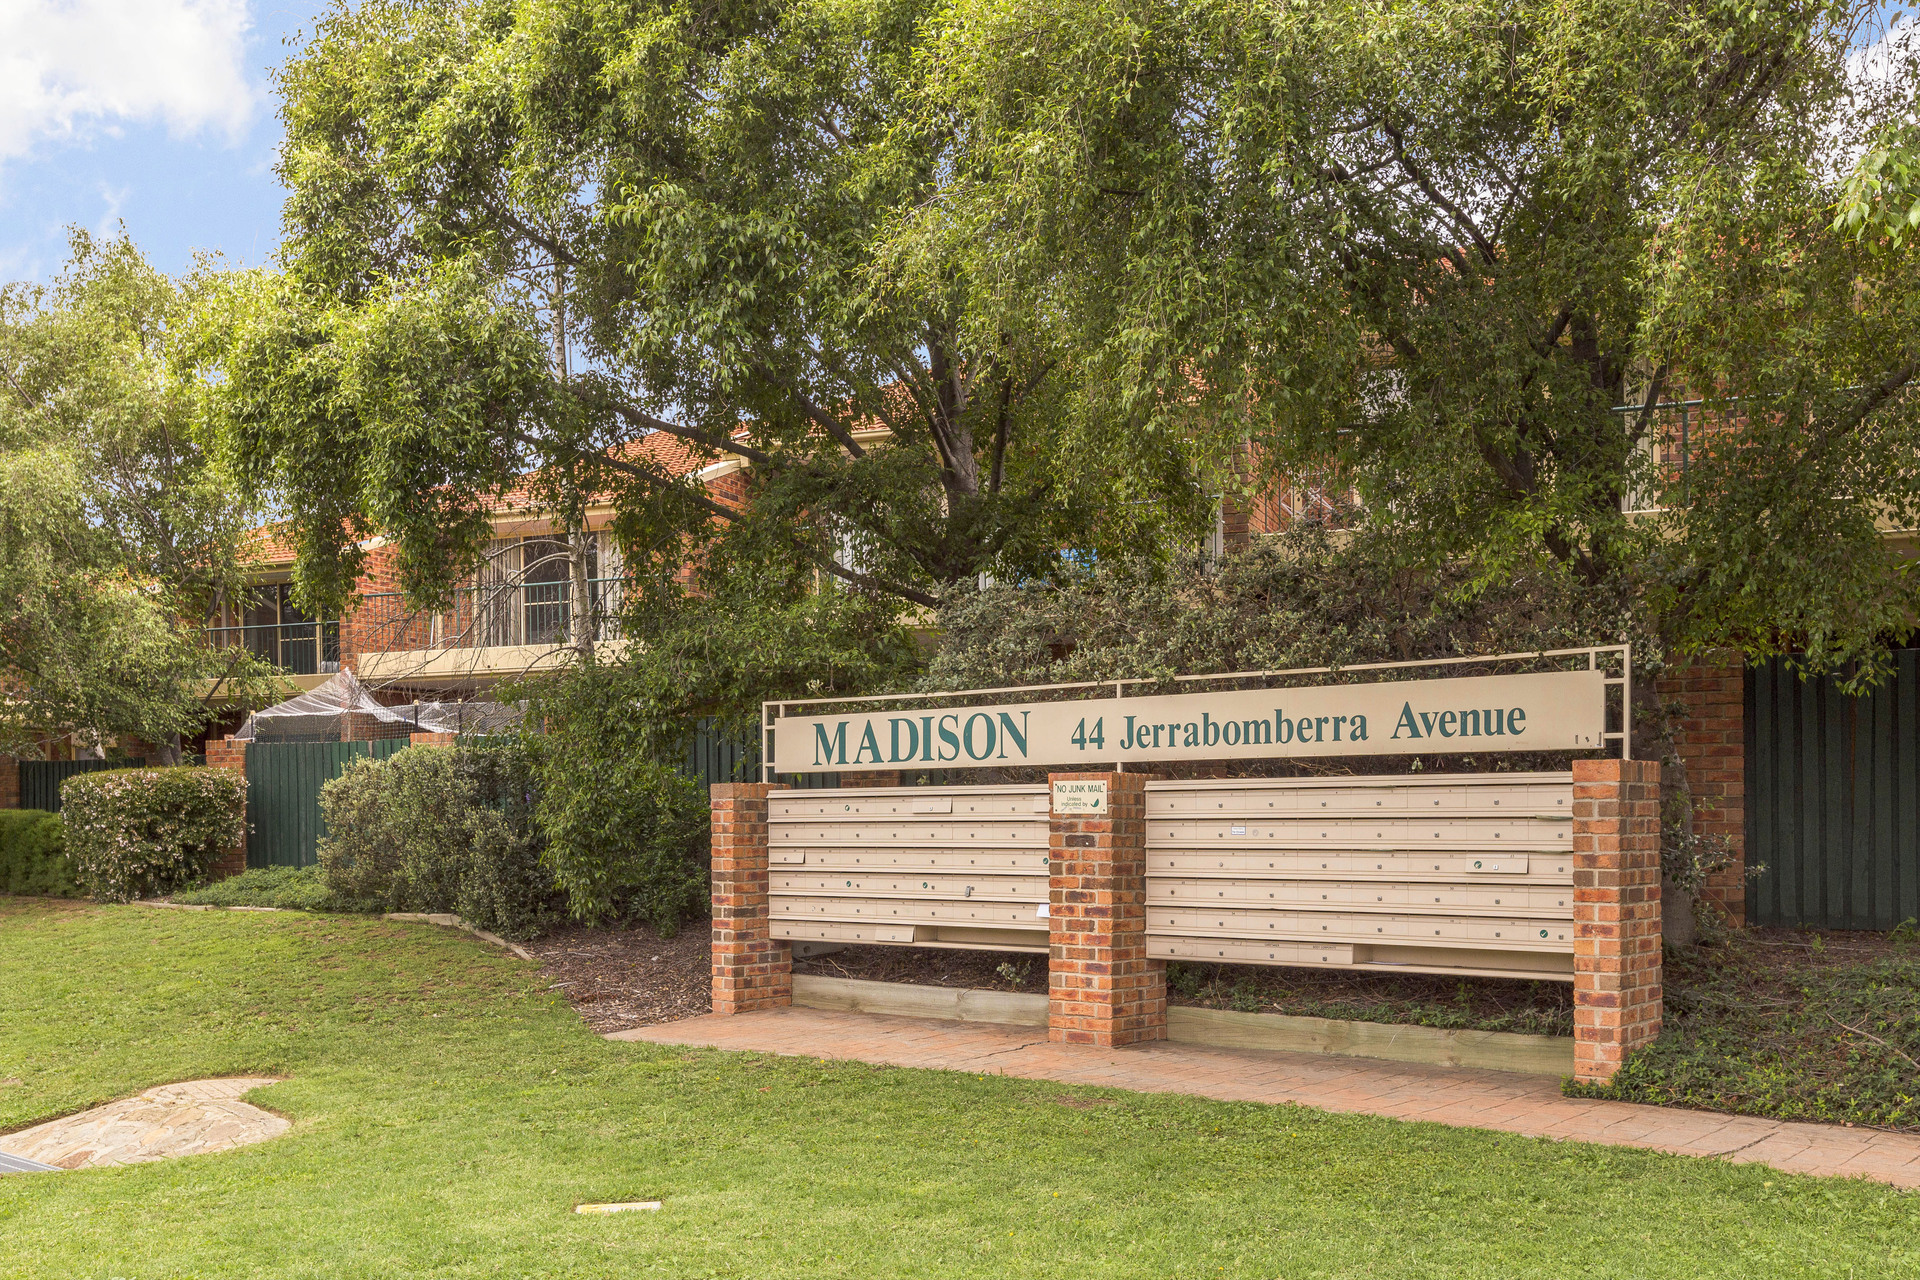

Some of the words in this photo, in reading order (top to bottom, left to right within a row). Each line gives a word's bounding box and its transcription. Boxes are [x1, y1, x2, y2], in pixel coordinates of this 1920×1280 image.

[812, 710, 1031, 766] MADISON
[1071, 716, 1105, 751] 44
[1119, 708, 1368, 750] Jerrabomberra
[1390, 701, 1526, 740] Avenue
[1057, 785, 1067, 793] NO
[1069, 785, 1086, 793] JUNK
[1088, 784, 1103, 792] MAIL
